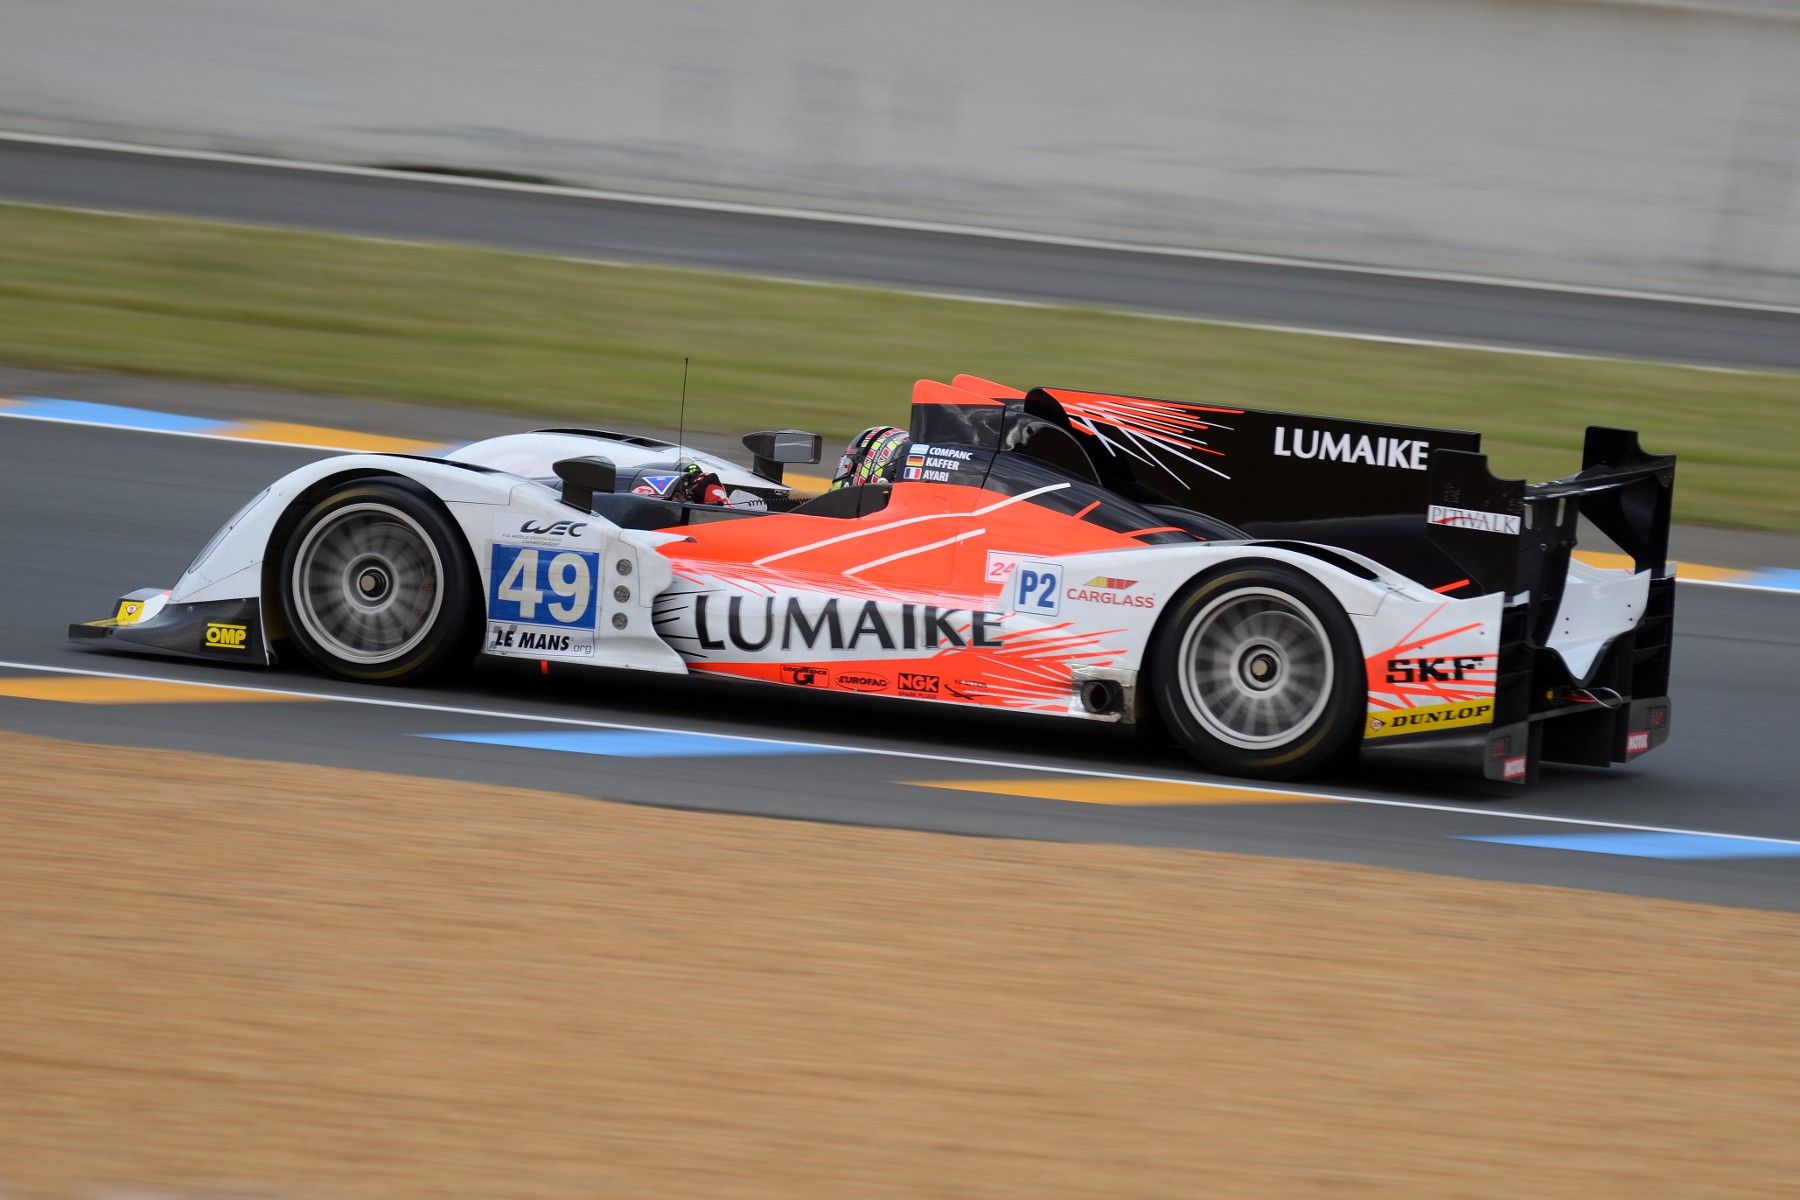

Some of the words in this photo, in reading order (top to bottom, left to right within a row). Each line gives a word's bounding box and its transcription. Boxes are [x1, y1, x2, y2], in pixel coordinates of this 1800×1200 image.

[928, 447, 973, 461] COMPANC
[1273, 426, 1429, 470] LUMAIKE
[925, 457, 960, 471] KAFFER
[922, 469, 949, 482] AYARI
[520, 519, 588, 537] WEC
[1431, 506, 1517, 534] PITWALK
[497, 548, 591, 623] 49
[1018, 569, 1056, 609] P2
[1066, 588, 1155, 608] CARGLASS
[695, 594, 1006, 651] LUMAIKE
[206, 627, 246, 645] OMP
[495, 630, 515, 647] LE
[518, 632, 570, 651] MANS
[1386, 656, 1484, 684] SKF
[899, 674, 939, 691] NGK
[1391, 705, 1490, 728] DUNLOP
